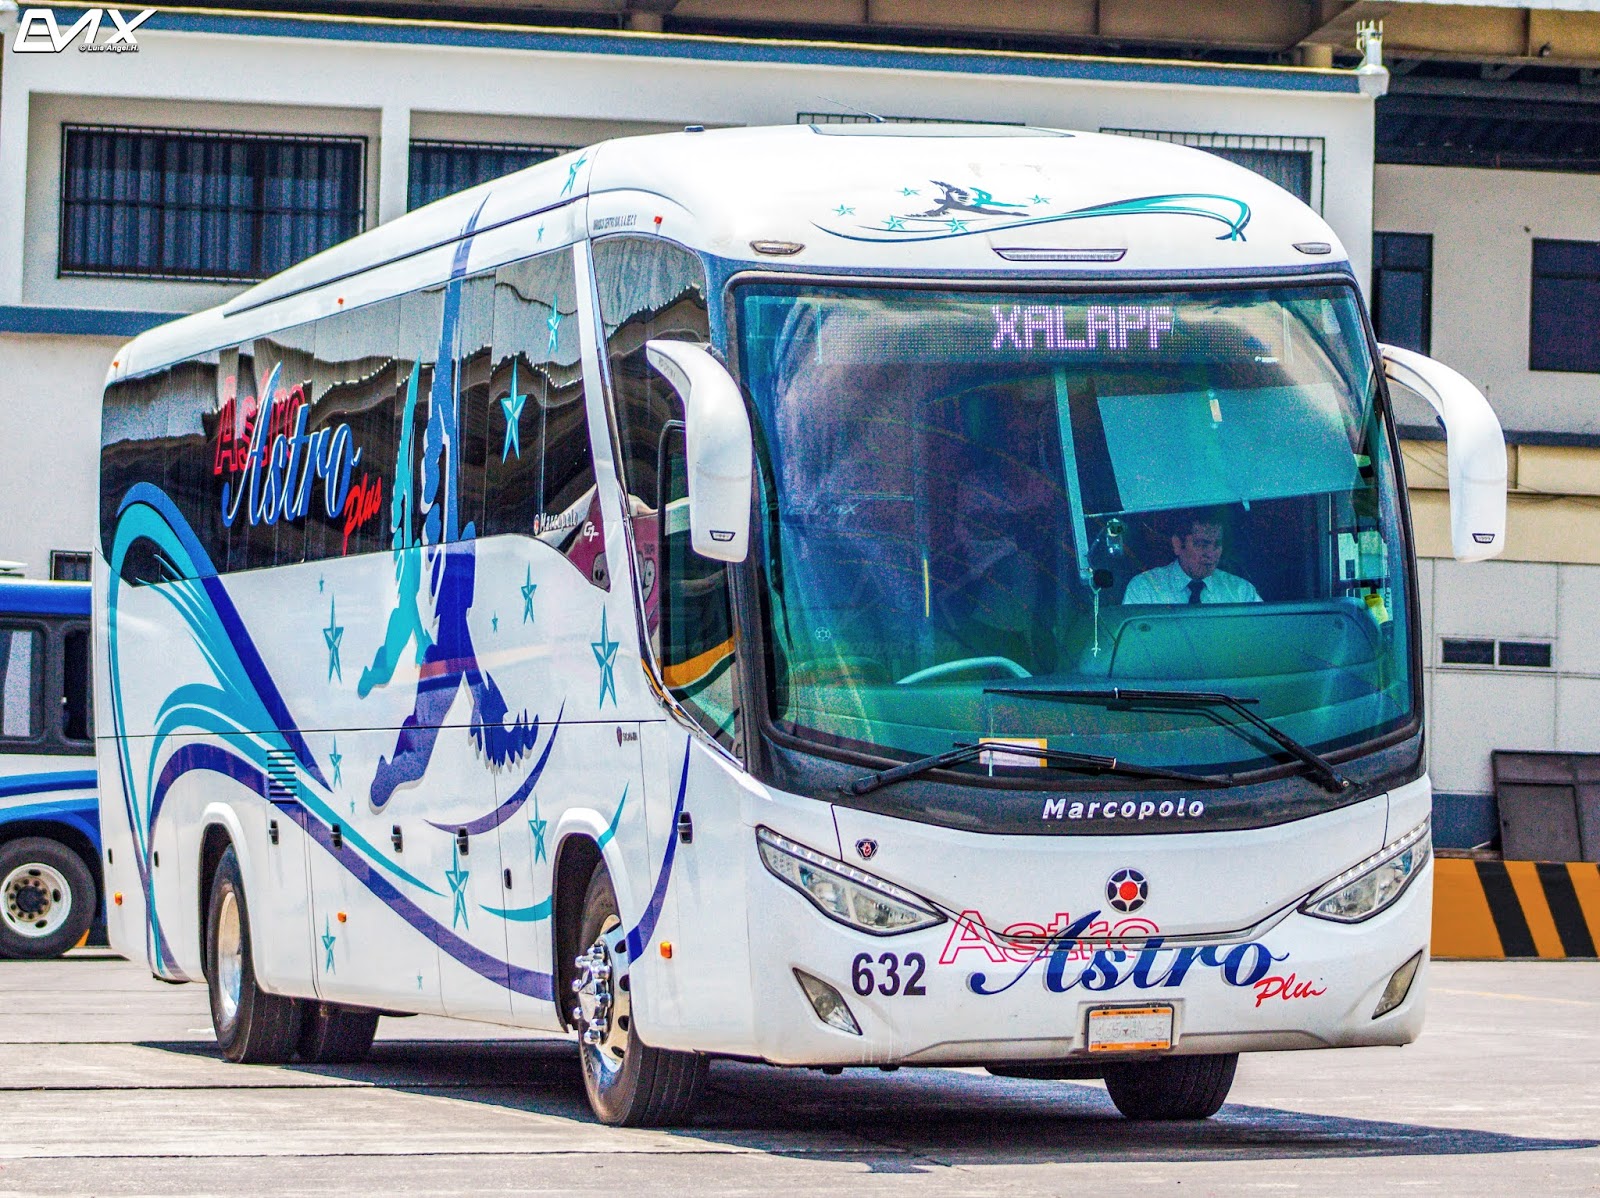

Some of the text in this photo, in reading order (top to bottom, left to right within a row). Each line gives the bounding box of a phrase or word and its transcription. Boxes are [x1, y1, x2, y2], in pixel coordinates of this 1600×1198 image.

[221, 360, 363, 528] Astro
[1042, 797, 1205, 820] Marcopolo
[852, 952, 926, 997] 632
[966, 909, 1290, 995] Astro
